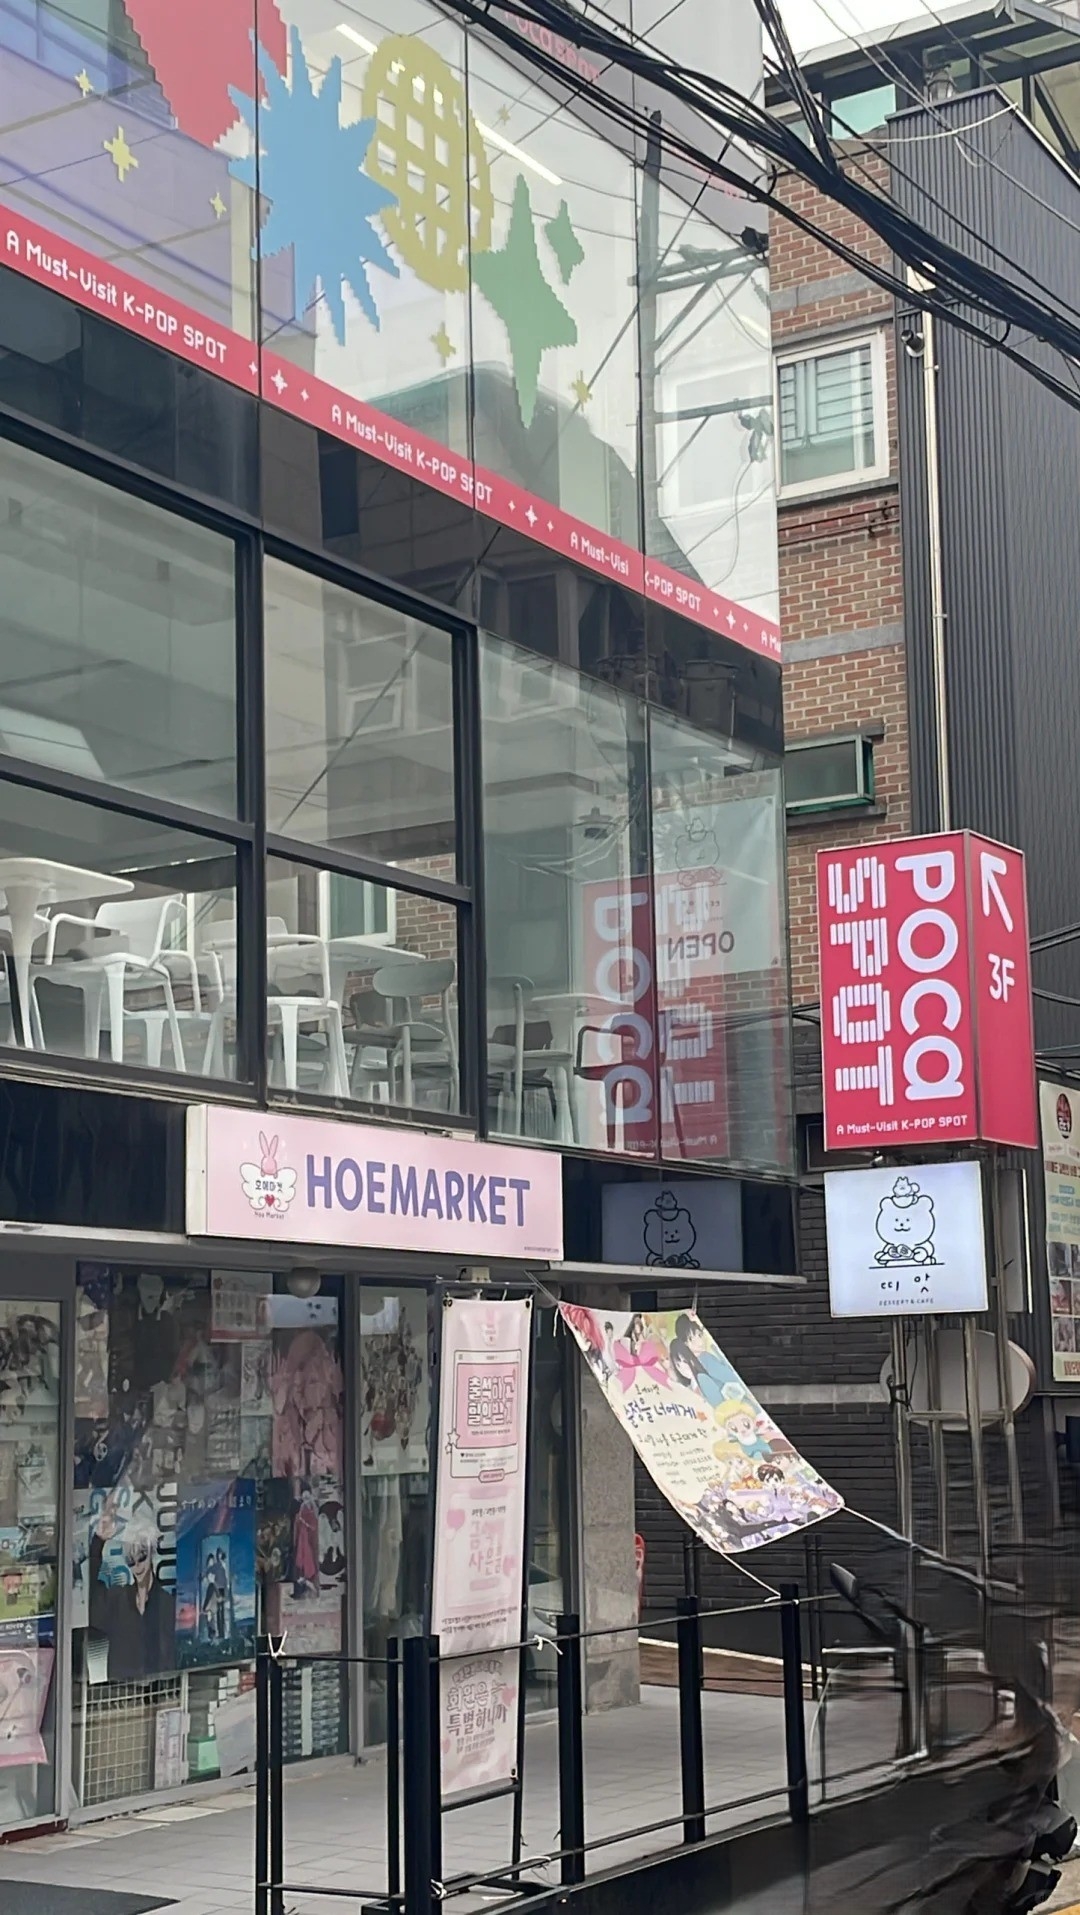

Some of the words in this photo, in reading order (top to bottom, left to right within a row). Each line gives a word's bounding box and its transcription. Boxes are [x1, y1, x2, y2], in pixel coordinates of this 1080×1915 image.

[6, 230, 20, 255] A
[26, 239, 118, 308] Must-Visit
[122, 291, 178, 337] K-POP
[182, 324, 228, 364] SPOT
[331, 404, 342, 424] A
[346, 412, 413, 464] Must-Visit
[416, 451, 457, 484] K-POP
[460, 471, 493, 504] SPOT
[570, 531, 579, 549] A
[676, 586, 701, 612] SPOT
[761, 630, 768, 647] A
[828, 856, 894, 1106] SPOT
[988, 953, 1016, 1003] 3F
[836, 1124, 844, 1135] A
[847, 1120, 898, 1135] Must-Visit
[901, 1117, 936, 1130] K-POP
[938, 1114, 968, 1128] SPOT
[306, 1154, 530, 1227] HOEMARKET
[654, 1401, 697, 1419] 너에게
[446, 1704, 508, 1736] 특별하니까
